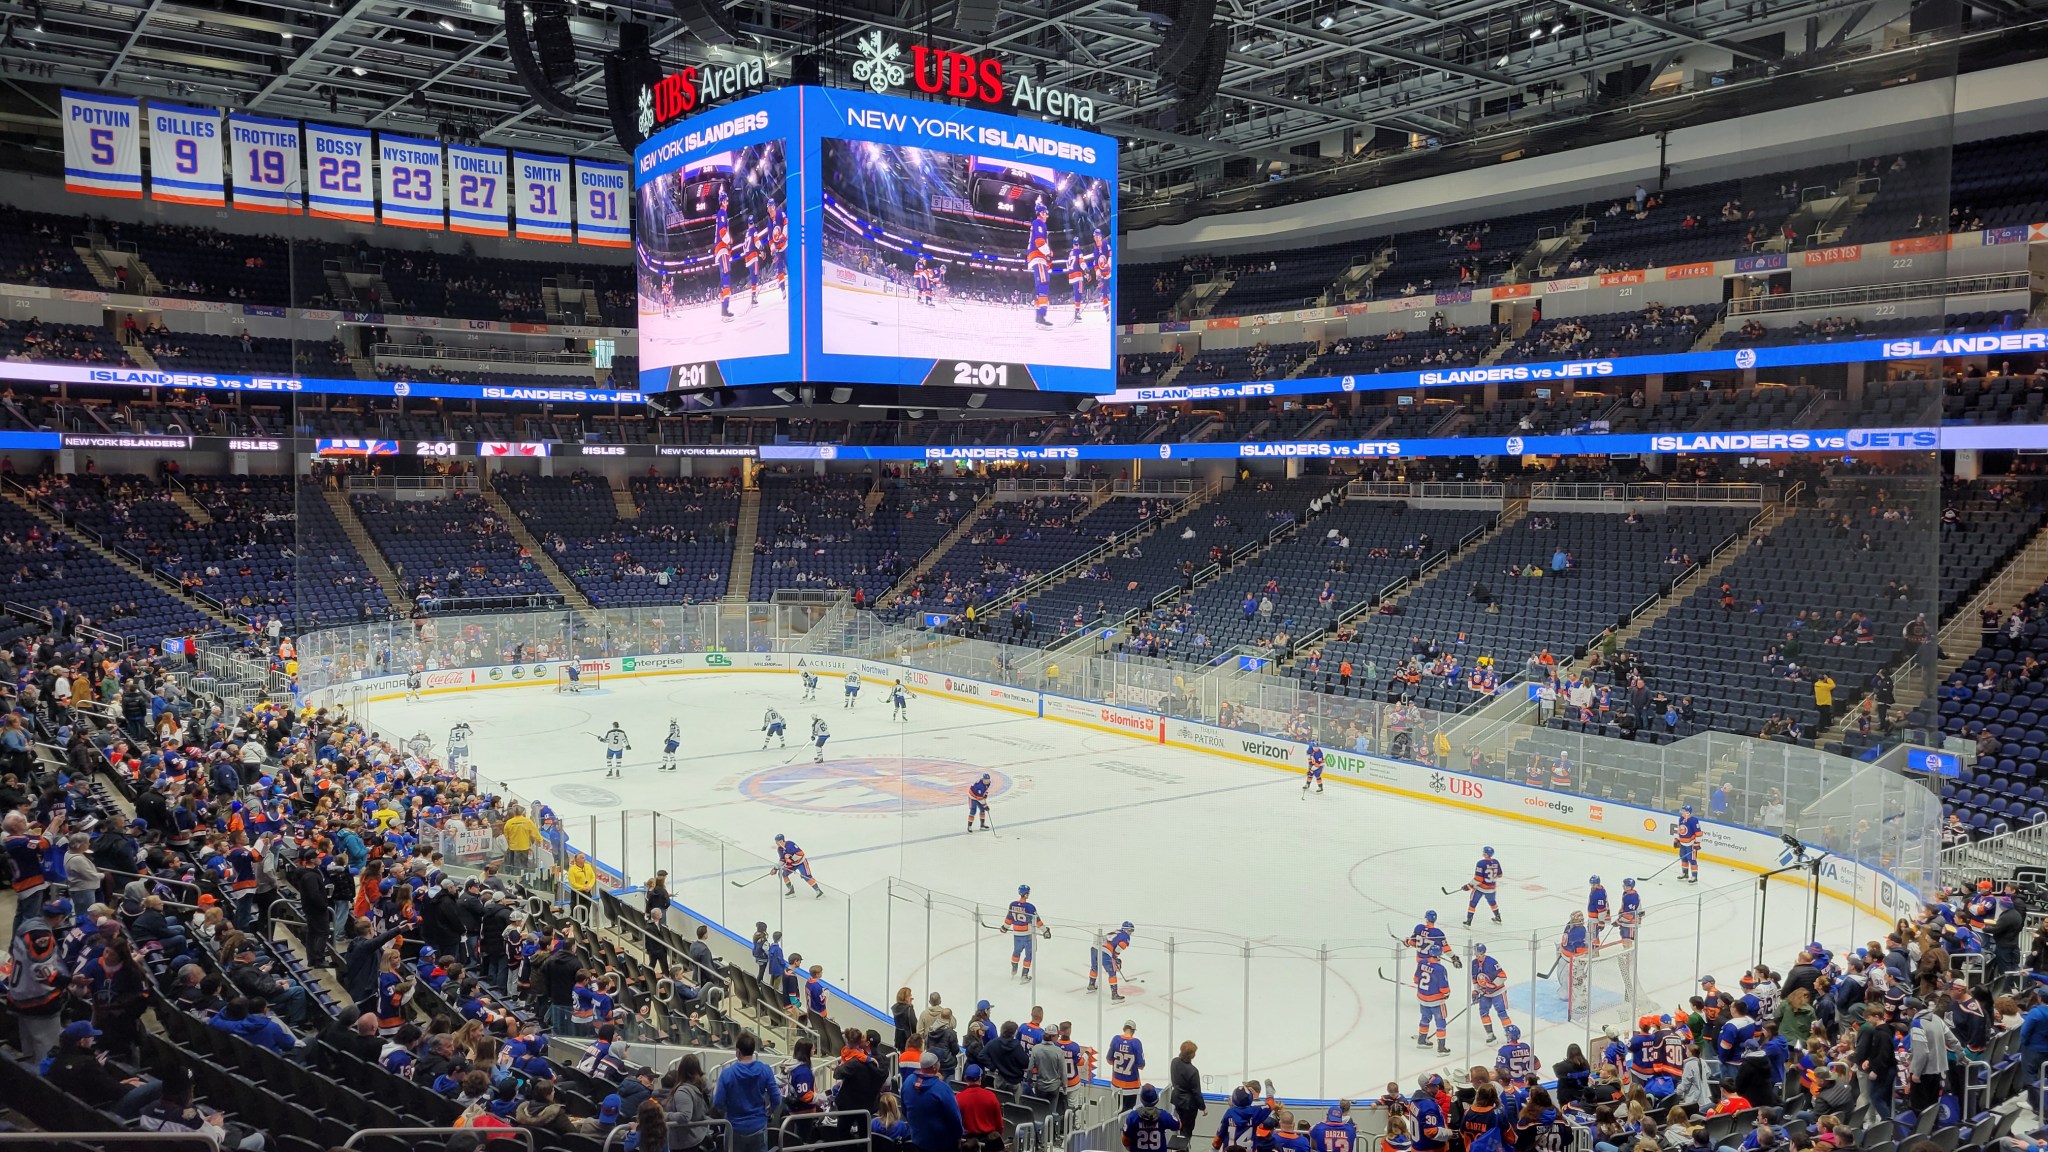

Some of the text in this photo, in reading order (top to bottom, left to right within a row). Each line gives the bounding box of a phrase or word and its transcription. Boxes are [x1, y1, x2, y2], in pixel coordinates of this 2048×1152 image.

[654, 57, 765, 124] UBS Arena
[911, 46, 1095, 122] UBS Arena
[71, 104, 130, 128] POTVIN
[156, 116, 215, 138] GILLIES
[848, 107, 1096, 164] NEW YORK ISLANDERS
[90, 128, 115, 166] 5
[233, 126, 297, 149] TROTTIER
[316, 137, 362, 157] BOSSY
[640, 111, 769, 173] NEW YORK ISLANDERS
[175, 138, 199, 175] 9
[383, 146, 439, 166] NYSTROM
[453, 155, 503, 176] TONELLI
[248, 149, 285, 185] 19
[319, 157, 361, 193] 22
[524, 164, 561, 183] SMITH
[392, 165, 432, 201] 23
[581, 171, 624, 189] GORING
[460, 174, 496, 209] 27
[529, 182, 558, 215] 31
[589, 189, 618, 221] 91
[1807, 245, 1856, 262] YES YES YES
[1893, 258, 1913, 269] 222
[1619, 288, 1633, 297] 221
[16, 300, 30, 308] 212
[1875, 305, 1896, 316] 222
[355, 312, 369, 322] NY
[1883, 333, 2048, 357] ISLANDER
[89, 369, 303, 391] ISLANDERS vs JETS
[678, 364, 707, 387] 2:01
[953, 362, 1008, 386] 2:01
[1419, 361, 1613, 385] ISLANDERS vs JETS
[482, 387, 587, 401] ISLANDERS
[589, 393, 607, 401] vs
[1137, 383, 1275, 400] ISLANDERS vs JETS
[66, 438, 186, 448] NEW YORK ISLANDERS
[229, 441, 278, 451] #ISLES
[416, 442, 457, 456] 2:01
[1240, 442, 1400, 457] ISLANDERS vs JETS
[1651, 430, 1938, 451] ISLANDERS vs JETS
[582, 446, 625, 455] #ISLES
[660, 447, 757, 456] NEW YORK ISLANDERS
[925, 447, 1079, 458] ISLANDERS vs JETS
[809, 659, 846, 669] ACRISURE
[861, 663, 889, 676] Northwell
[366, 680, 406, 692] HYUNDA
[913, 672, 929, 685] UBS
[1109, 711, 1145, 730] slomin's
[455, 732, 466, 741] 54
[612, 735, 619, 744] 5
[1194, 733, 1224, 748] PATRÓN
[1241, 740, 1289, 760] verizon
[1337, 756, 1366, 773] NFP
[1449, 777, 1484, 799] UBS
[1524, 796, 1574, 814] coloredge
[1711, 831, 1722, 840] big
[1714, 840, 1748, 852] gamedays!
[1419, 972, 1431, 991] 2
[1119, 1044, 1129, 1053] LEE
[1665, 1045, 1683, 1066] 30
[1113, 1052, 1135, 1076] 27
[1496, 1055, 1506, 1064] 53
[797, 1082, 808, 1094] 30
[1425, 1114, 1437, 1125] 30
[1136, 1130, 1162, 1150] 29
[1228, 1125, 1254, 1152] 14
[1324, 1130, 1349, 1139] BARZAL
